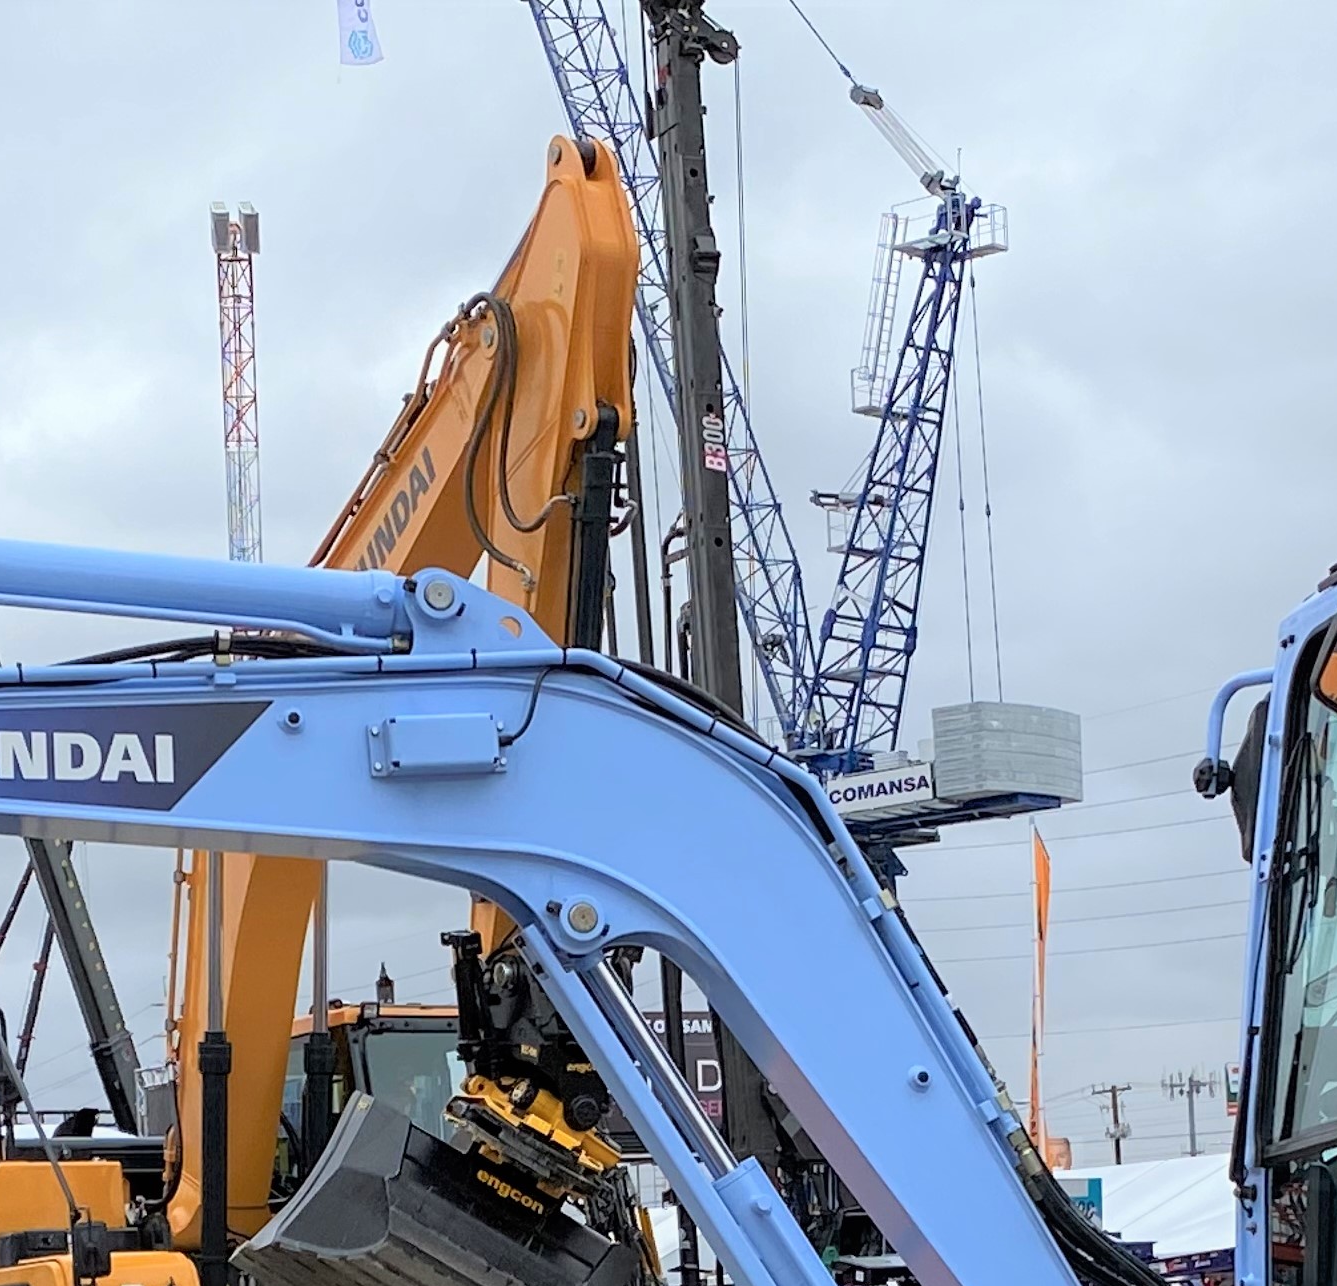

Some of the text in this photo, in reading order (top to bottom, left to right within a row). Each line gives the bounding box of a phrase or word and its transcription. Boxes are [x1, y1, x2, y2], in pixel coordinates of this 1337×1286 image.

[702, 413, 727, 472] B300
[829, 775, 930, 805] COMANSA
[476, 1167, 544, 1215] engcon
